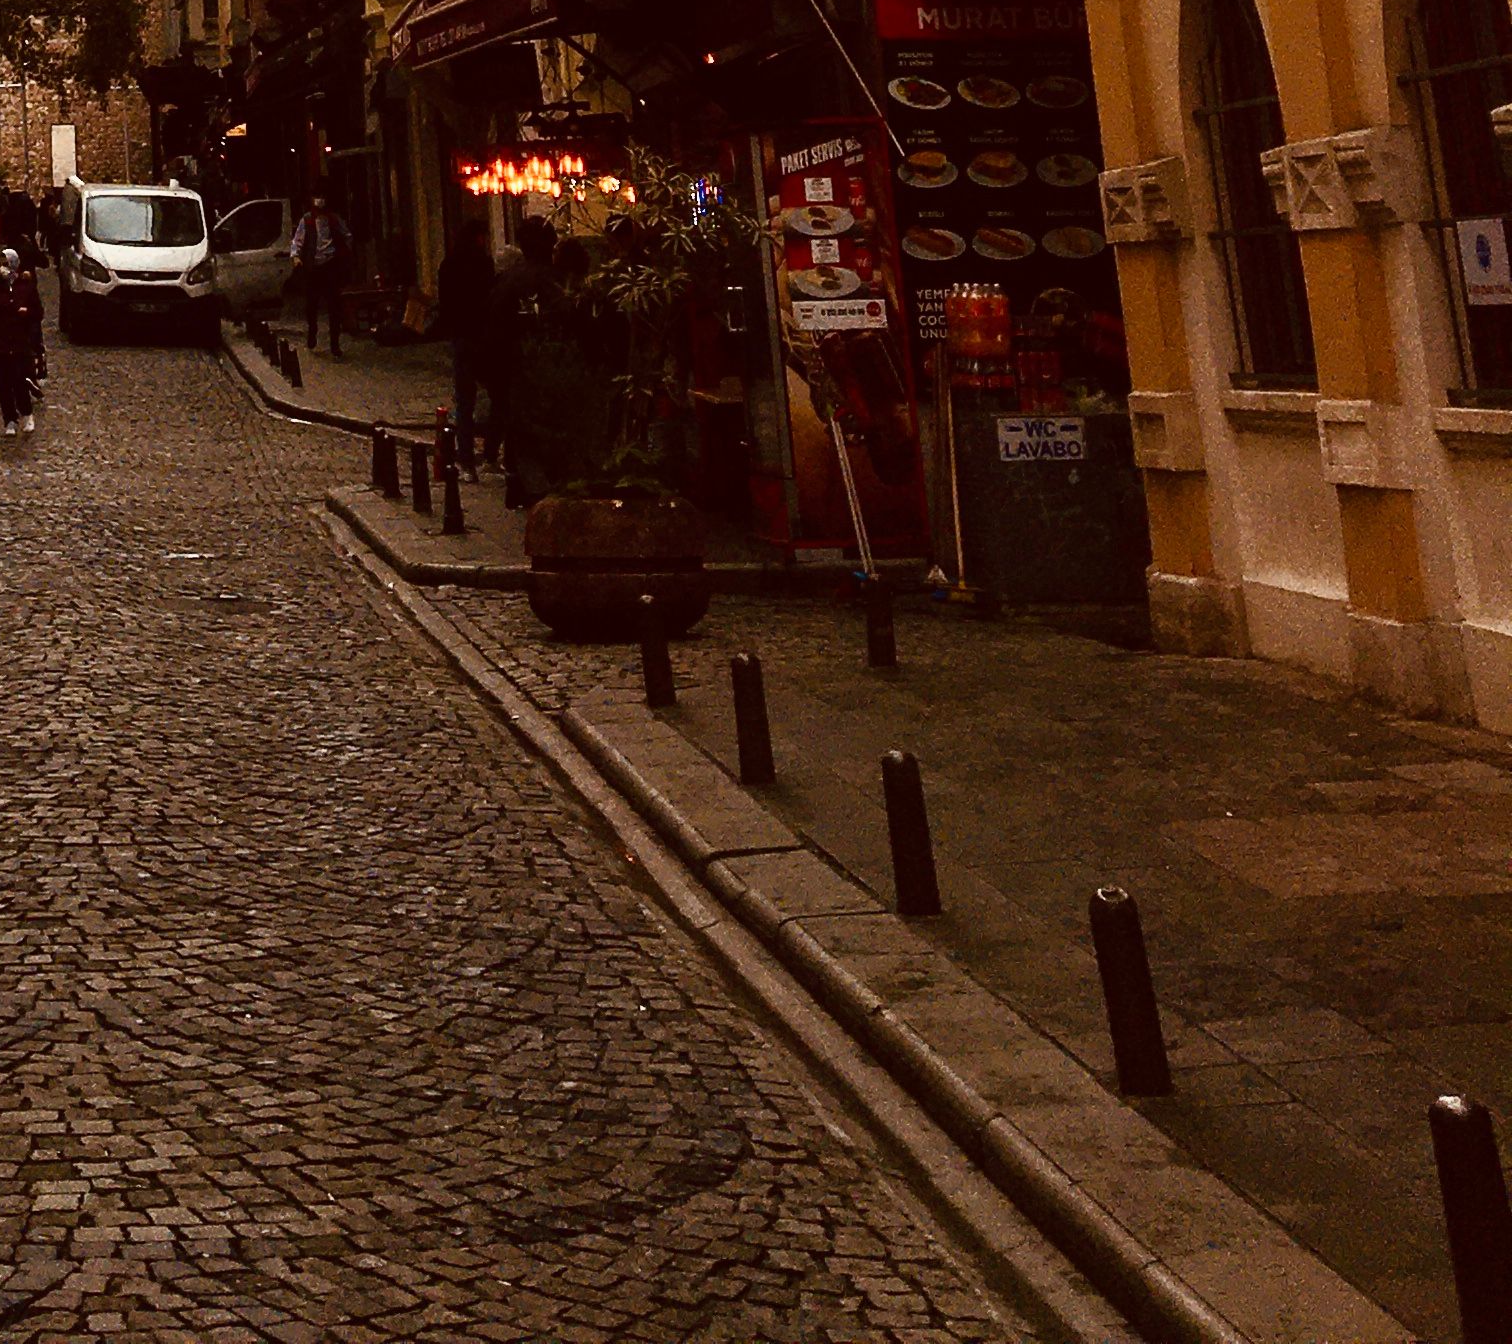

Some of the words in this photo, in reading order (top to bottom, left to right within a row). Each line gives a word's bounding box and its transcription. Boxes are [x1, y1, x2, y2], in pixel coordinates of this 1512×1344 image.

[917, 6, 1022, 32] MURAT
[780, 148, 809, 176] PAKET
[918, 315, 947, 326] COC
[919, 328, 948, 339] UNU
[1024, 419, 1056, 438] WC
[1004, 441, 1082, 458] LAVABO
